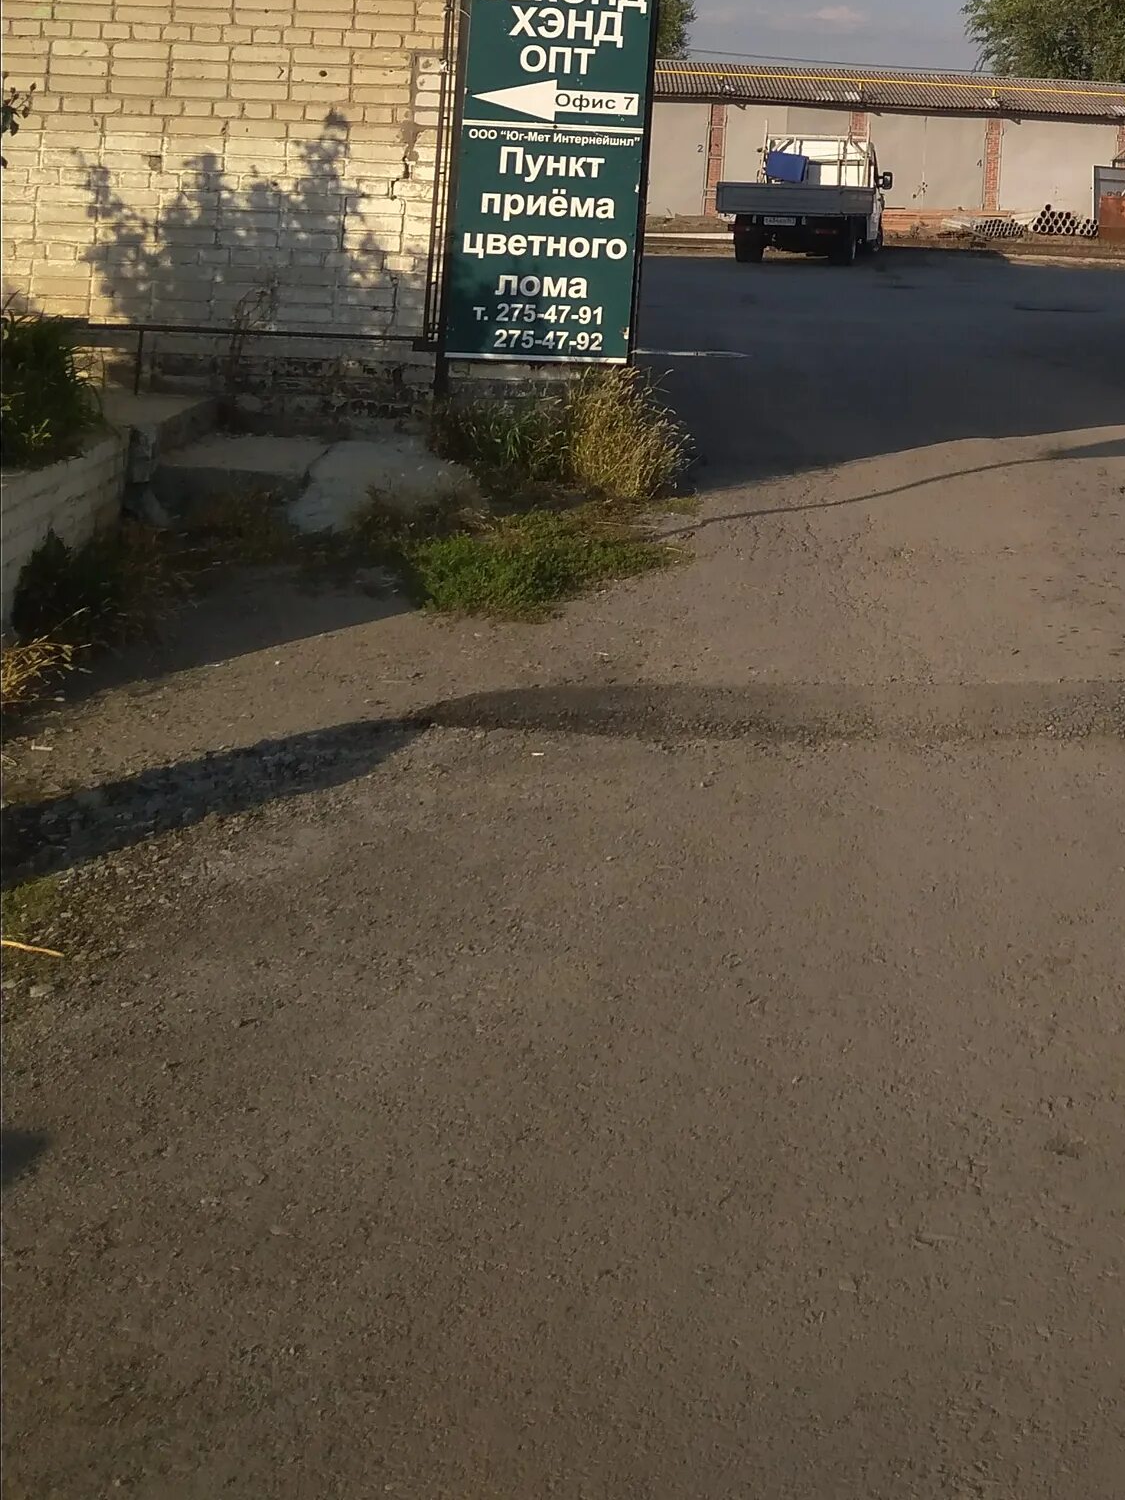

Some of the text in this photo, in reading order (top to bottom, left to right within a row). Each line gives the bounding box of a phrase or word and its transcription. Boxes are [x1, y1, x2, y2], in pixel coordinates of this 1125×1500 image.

[508, 5, 623, 48] ХЭНД
[519, 45, 596, 75] ОПТ
[554, 93, 635, 111] Офис 7
[468, 128, 498, 140] ООО
[501, 130, 551, 143] “Юг-Мет
[499, 145, 605, 182] Пункт
[481, 189, 615, 221] приёма
[462, 231, 627, 259] цветного
[494, 273, 588, 299] лома
[473, 303, 603, 325] т. 275-47-91
[494, 329, 603, 351] 275-47-92
